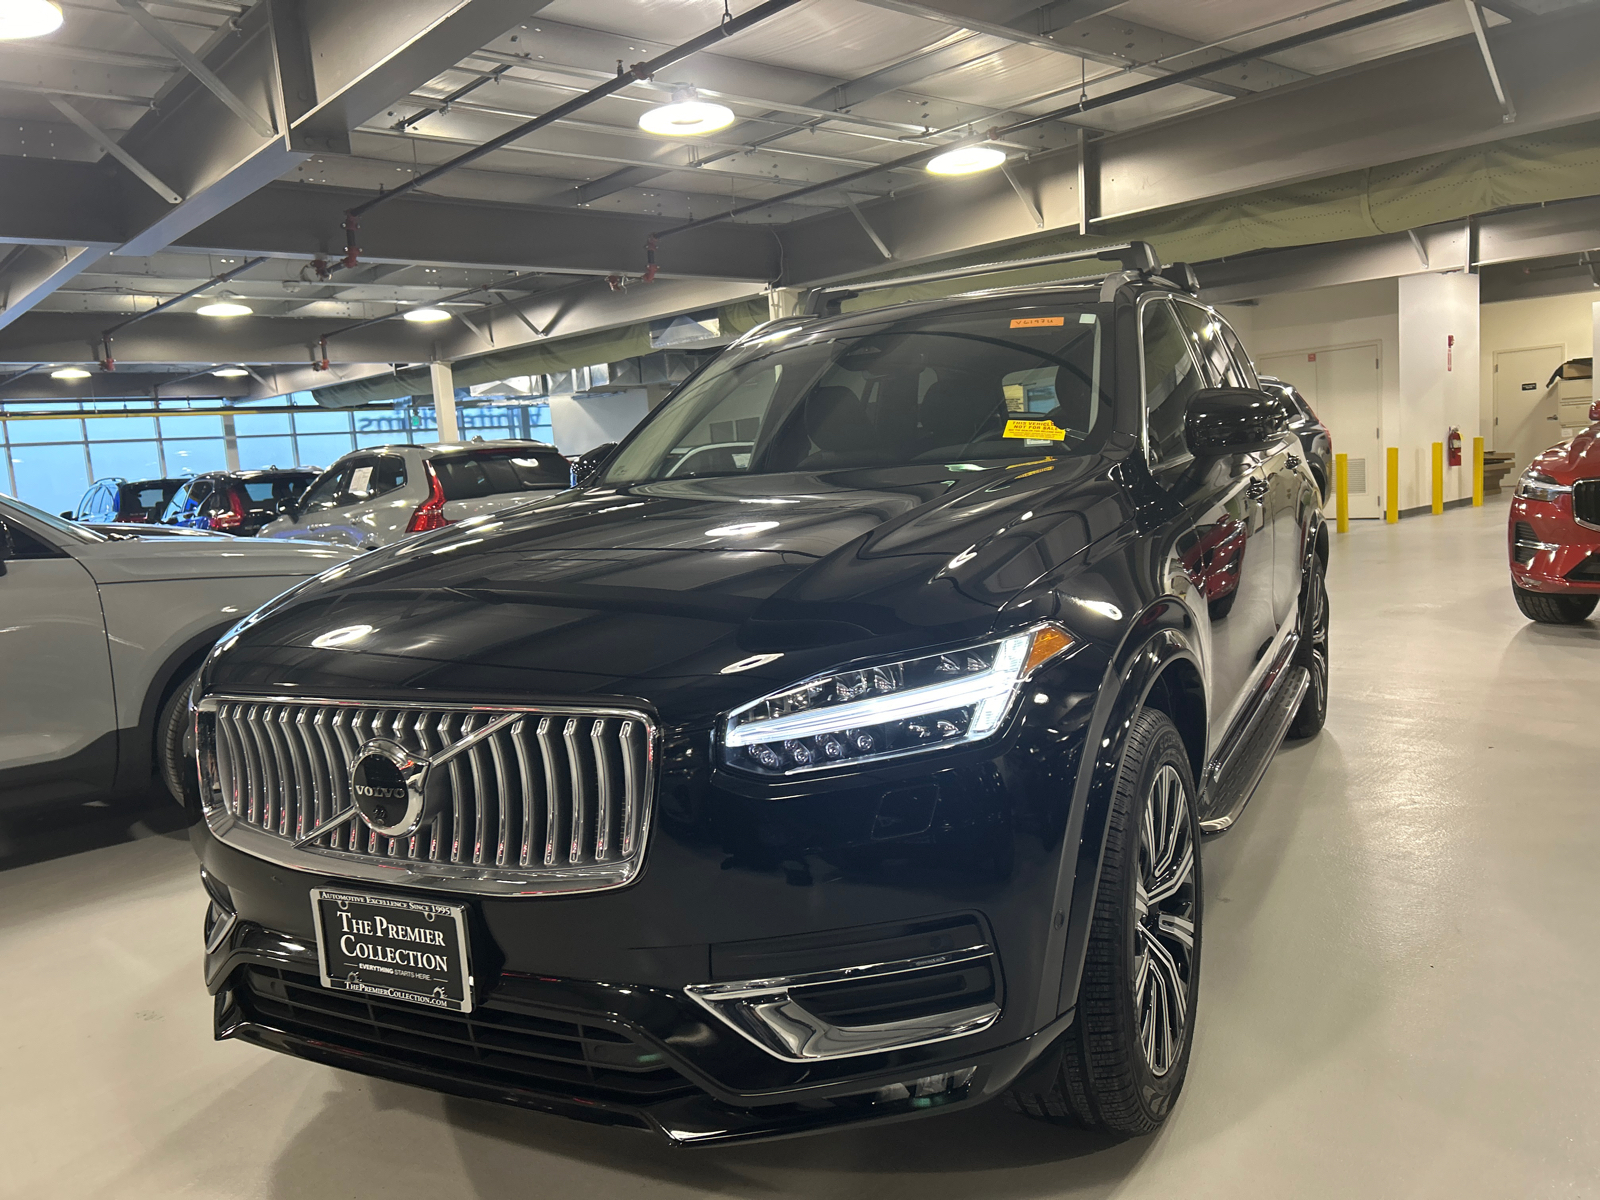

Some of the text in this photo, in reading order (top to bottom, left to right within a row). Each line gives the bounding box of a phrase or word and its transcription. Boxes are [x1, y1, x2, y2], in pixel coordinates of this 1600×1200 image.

[355, 785, 406, 799] VOLVO
[321, 891, 450, 915] AUTOMOTIVE EXCELLENCE SINCE 1995
[337, 911, 446, 947] THE PREMIER
[340, 934, 448, 972] COLLECTION
[358, 963, 394, 974] EVERYTHING
[394, 969, 415, 979] STARTS
